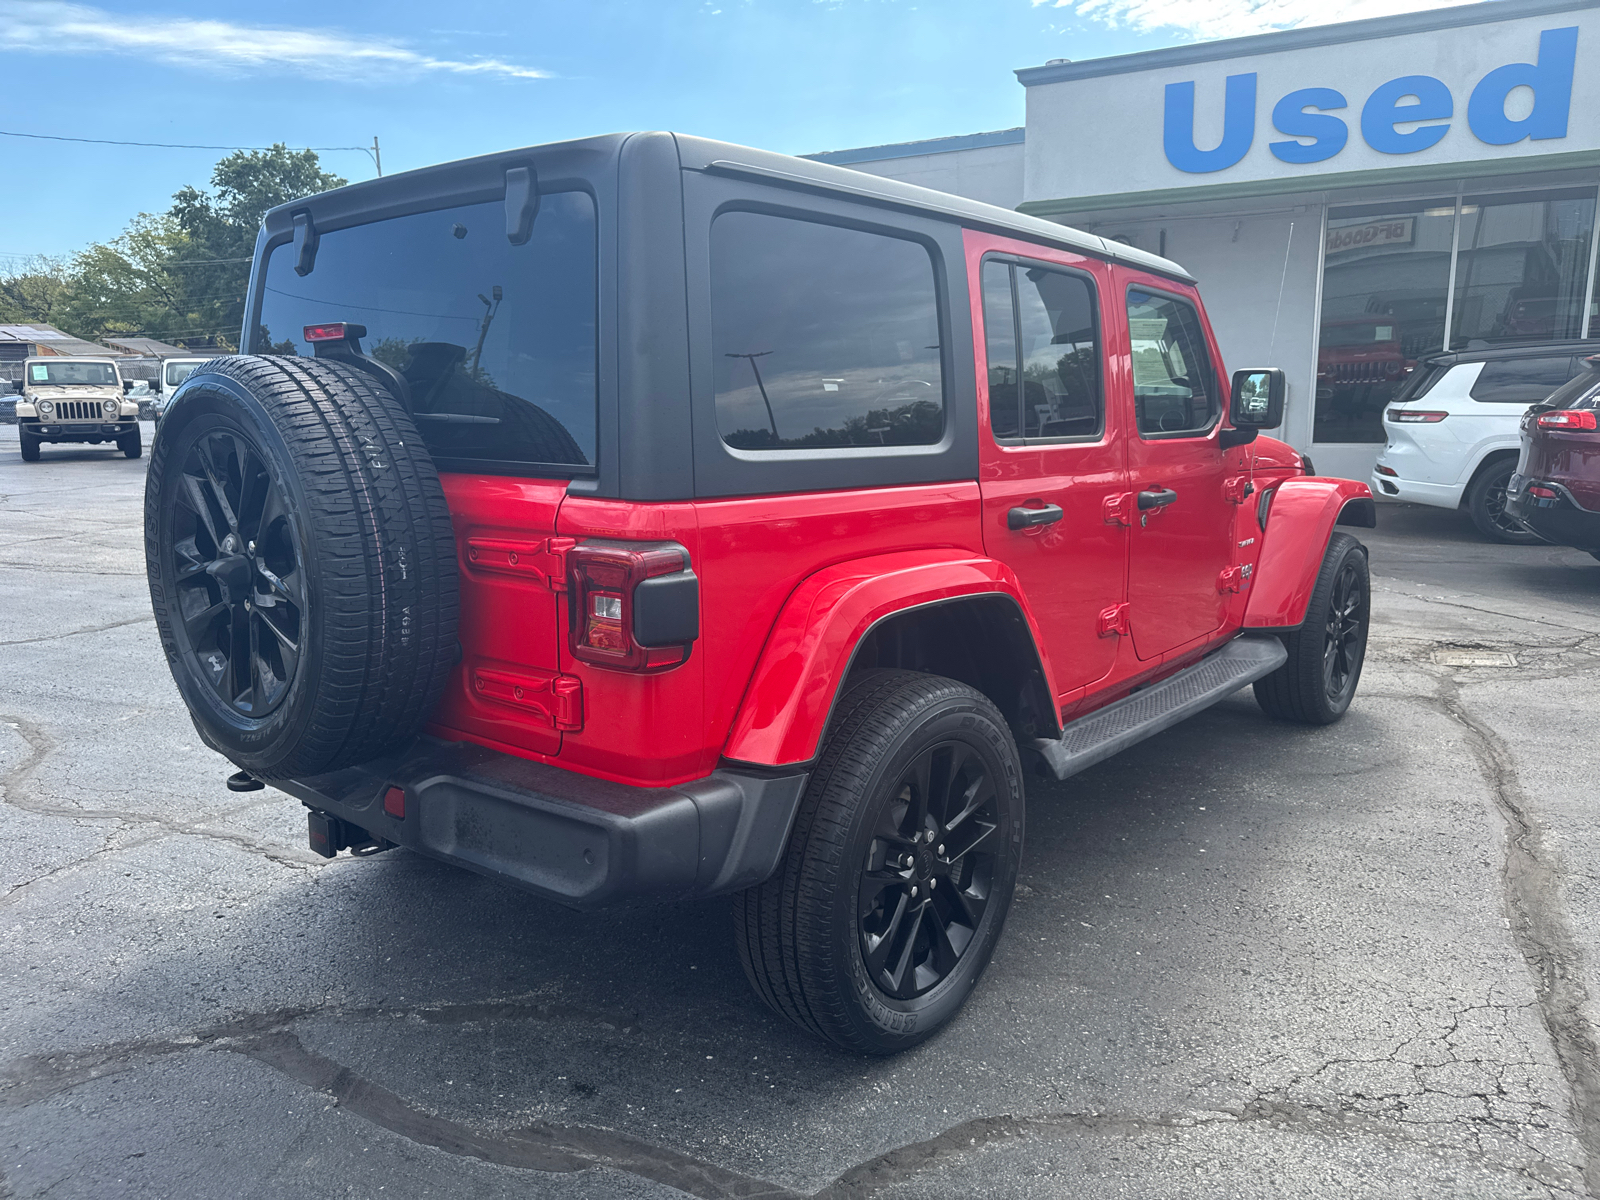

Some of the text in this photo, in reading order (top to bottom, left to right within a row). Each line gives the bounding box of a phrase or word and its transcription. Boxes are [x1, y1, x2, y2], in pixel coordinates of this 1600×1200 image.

[1163, 26, 1579, 173] Used
[956, 715, 1020, 800] DUELER
[848, 869, 919, 1034] BRIDGESTONE
